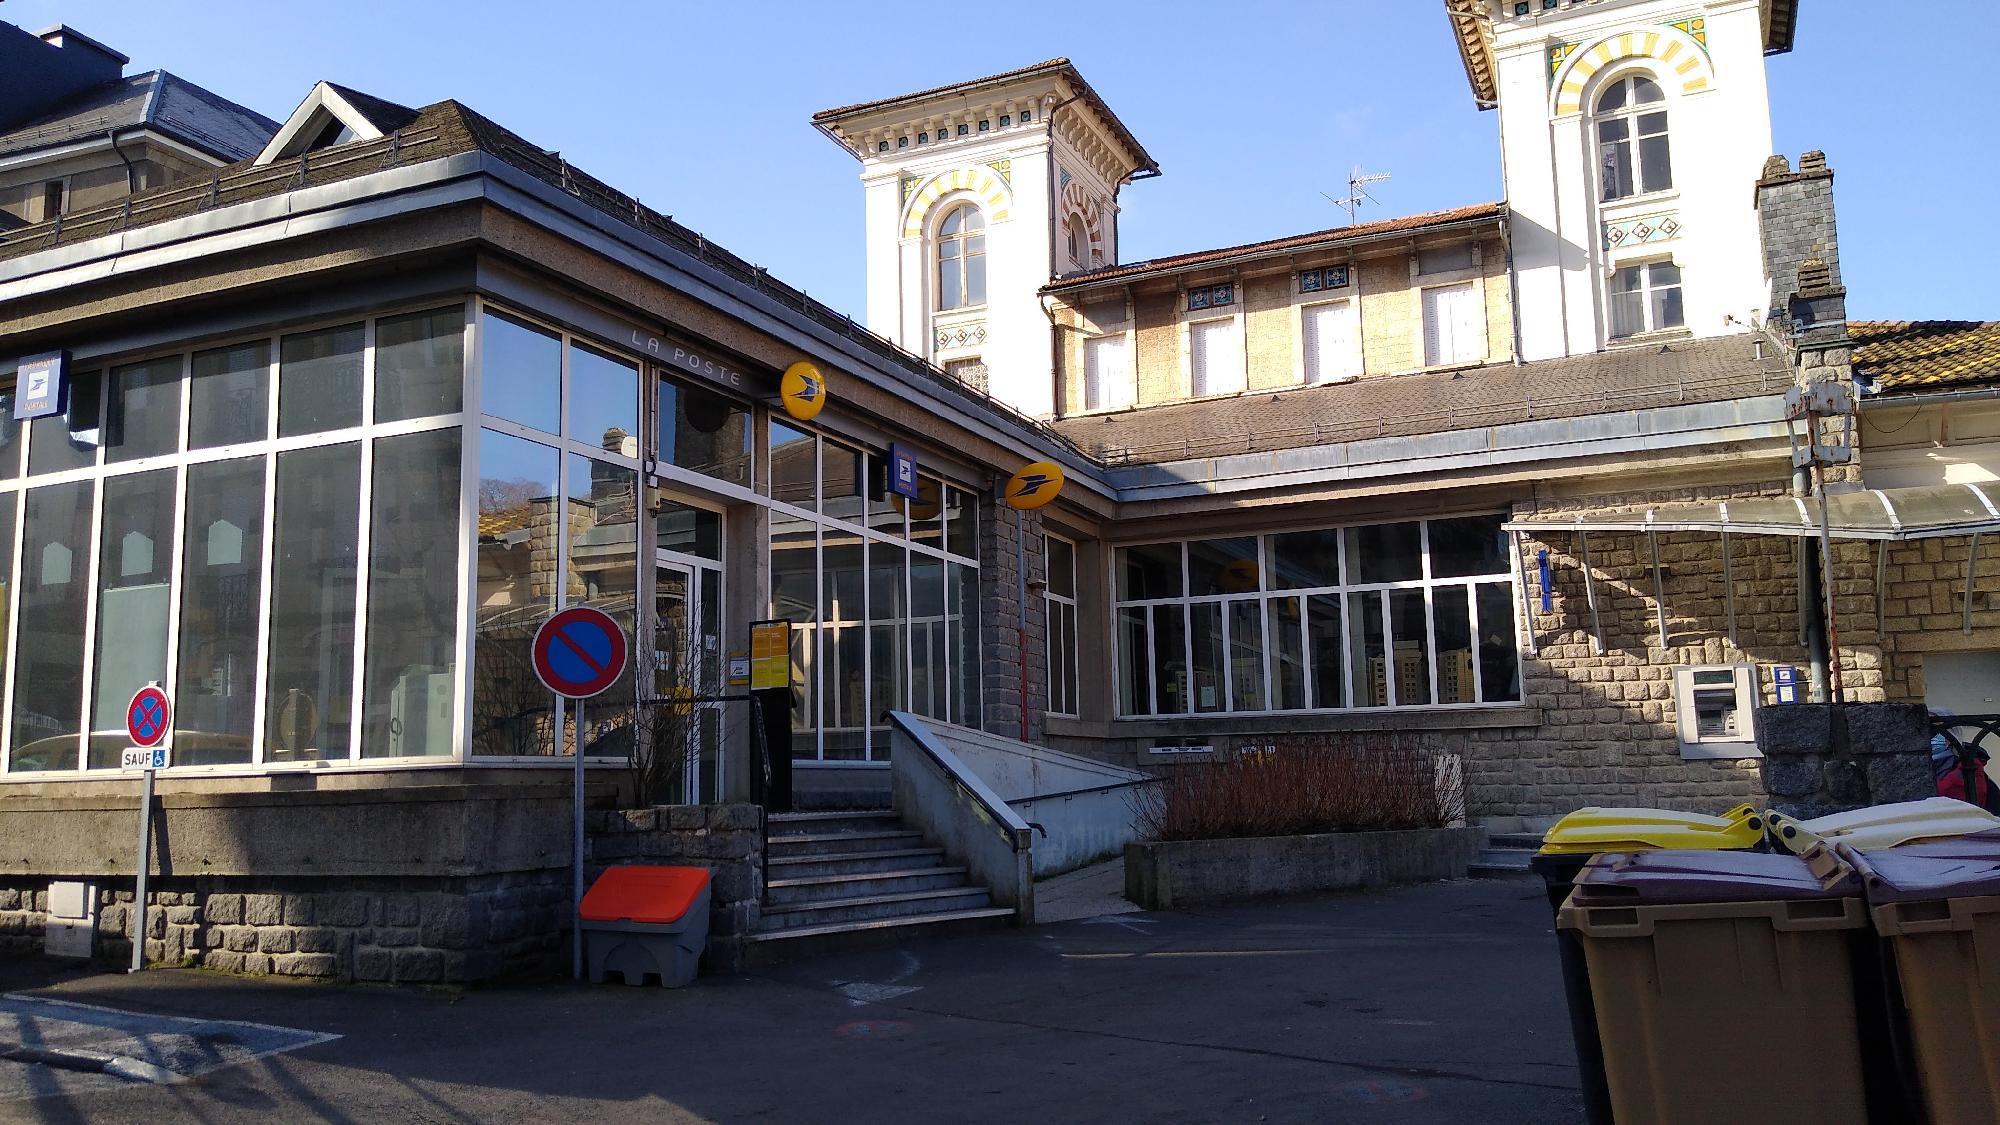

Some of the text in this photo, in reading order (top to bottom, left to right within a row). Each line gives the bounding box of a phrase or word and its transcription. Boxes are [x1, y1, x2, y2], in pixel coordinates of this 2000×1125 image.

[631, 329, 741, 386] LA POSTE
[125, 753, 151, 765] SAUF
